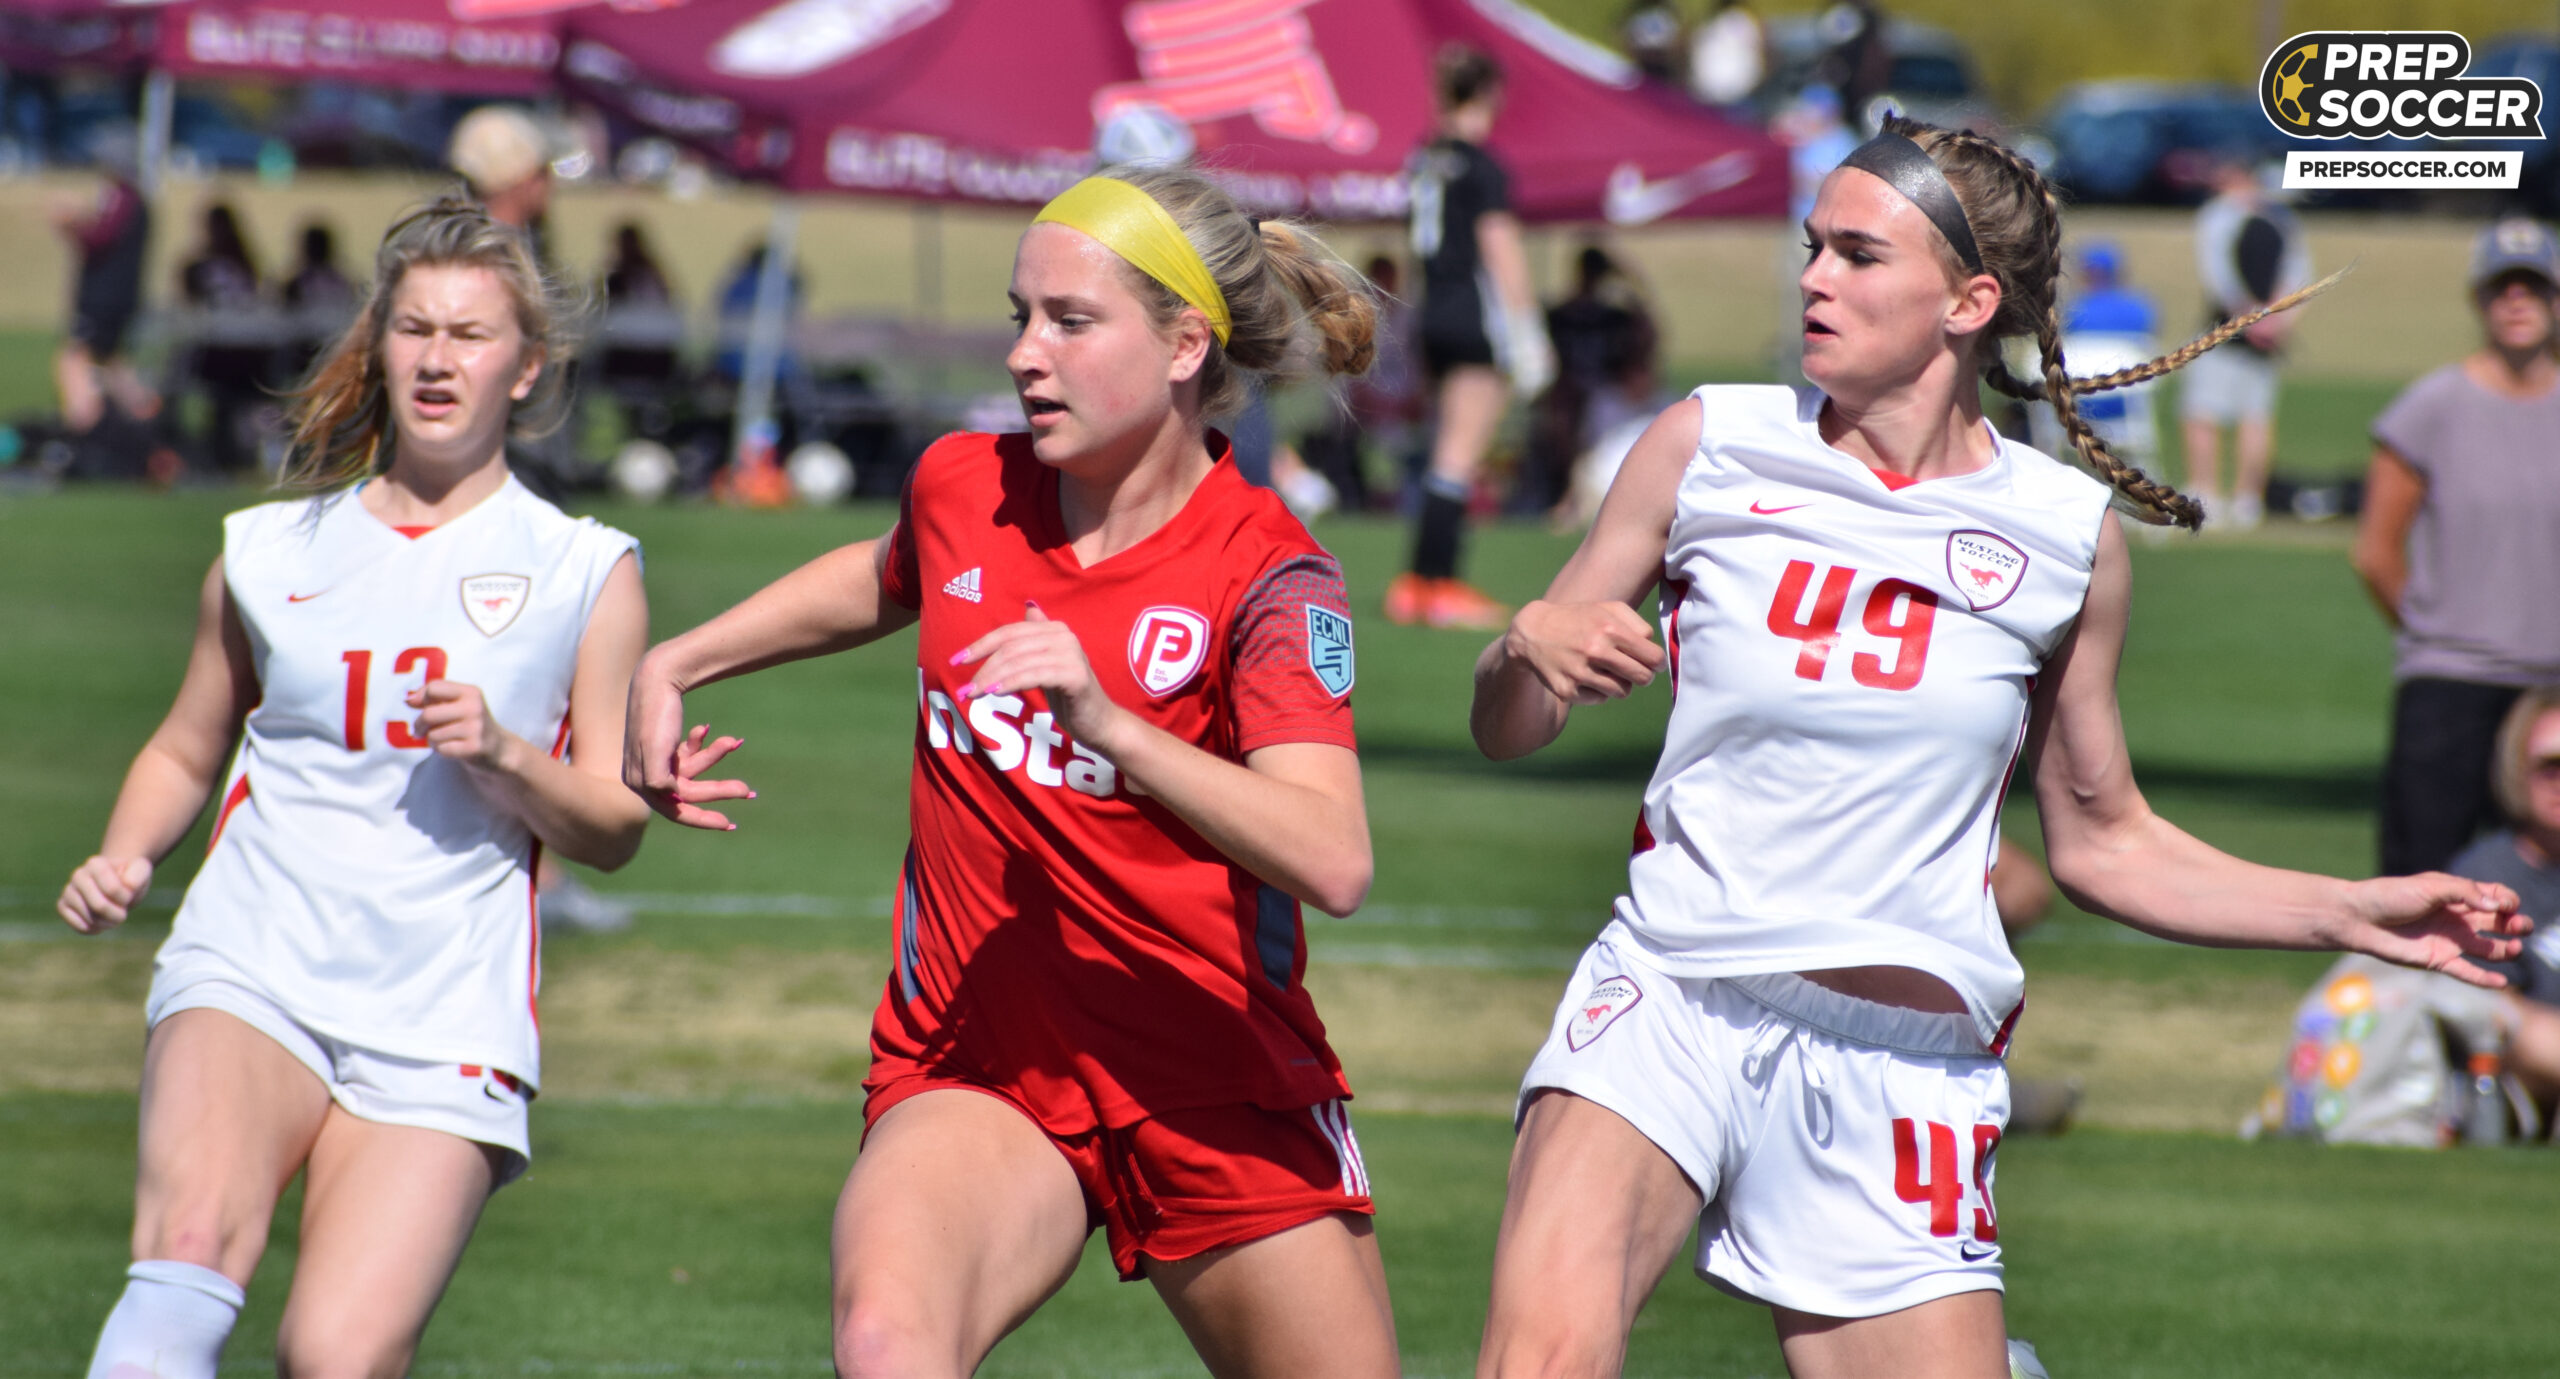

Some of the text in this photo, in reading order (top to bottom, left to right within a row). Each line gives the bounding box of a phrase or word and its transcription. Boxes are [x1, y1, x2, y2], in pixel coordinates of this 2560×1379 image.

[1957, 538, 2019, 565] MUSTANG
[1960, 546, 2012, 569] SOCCER
[943, 583, 982, 603] adidas
[1311, 611, 1350, 648] ECNL
[1767, 559, 1939, 691] 49
[343, 647, 448, 752] 13
